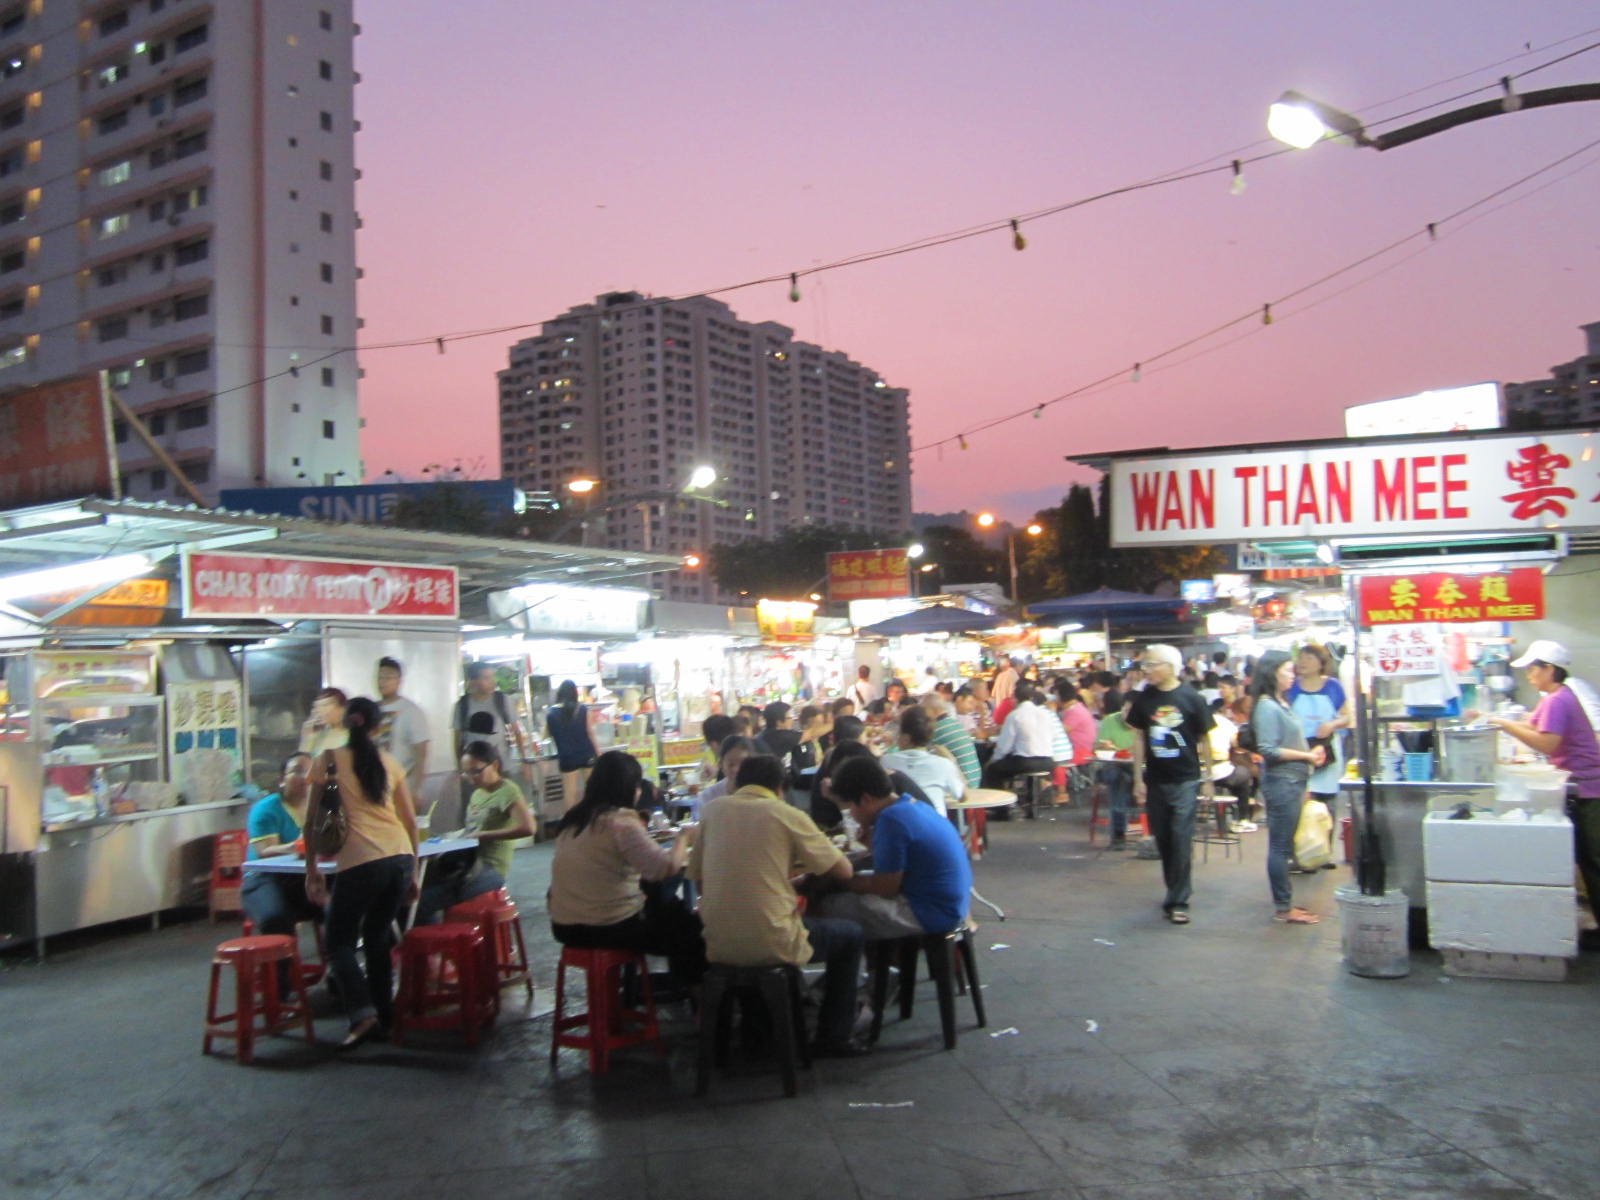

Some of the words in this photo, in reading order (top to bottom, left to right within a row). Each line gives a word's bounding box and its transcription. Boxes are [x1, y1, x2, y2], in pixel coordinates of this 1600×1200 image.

[1130, 469, 1215, 532] WAN
[1235, 460, 1352, 527] THAN
[1373, 453, 1470, 522] MEE
[1502, 443, 1600, 521] 雲
[195, 570, 253, 598] CHAR
[257, 572, 308, 600] KOAY
[1368, 609, 1414, 622] WAN
[1420, 606, 1481, 620] THAN
[1486, 604, 1536, 617] MEE
